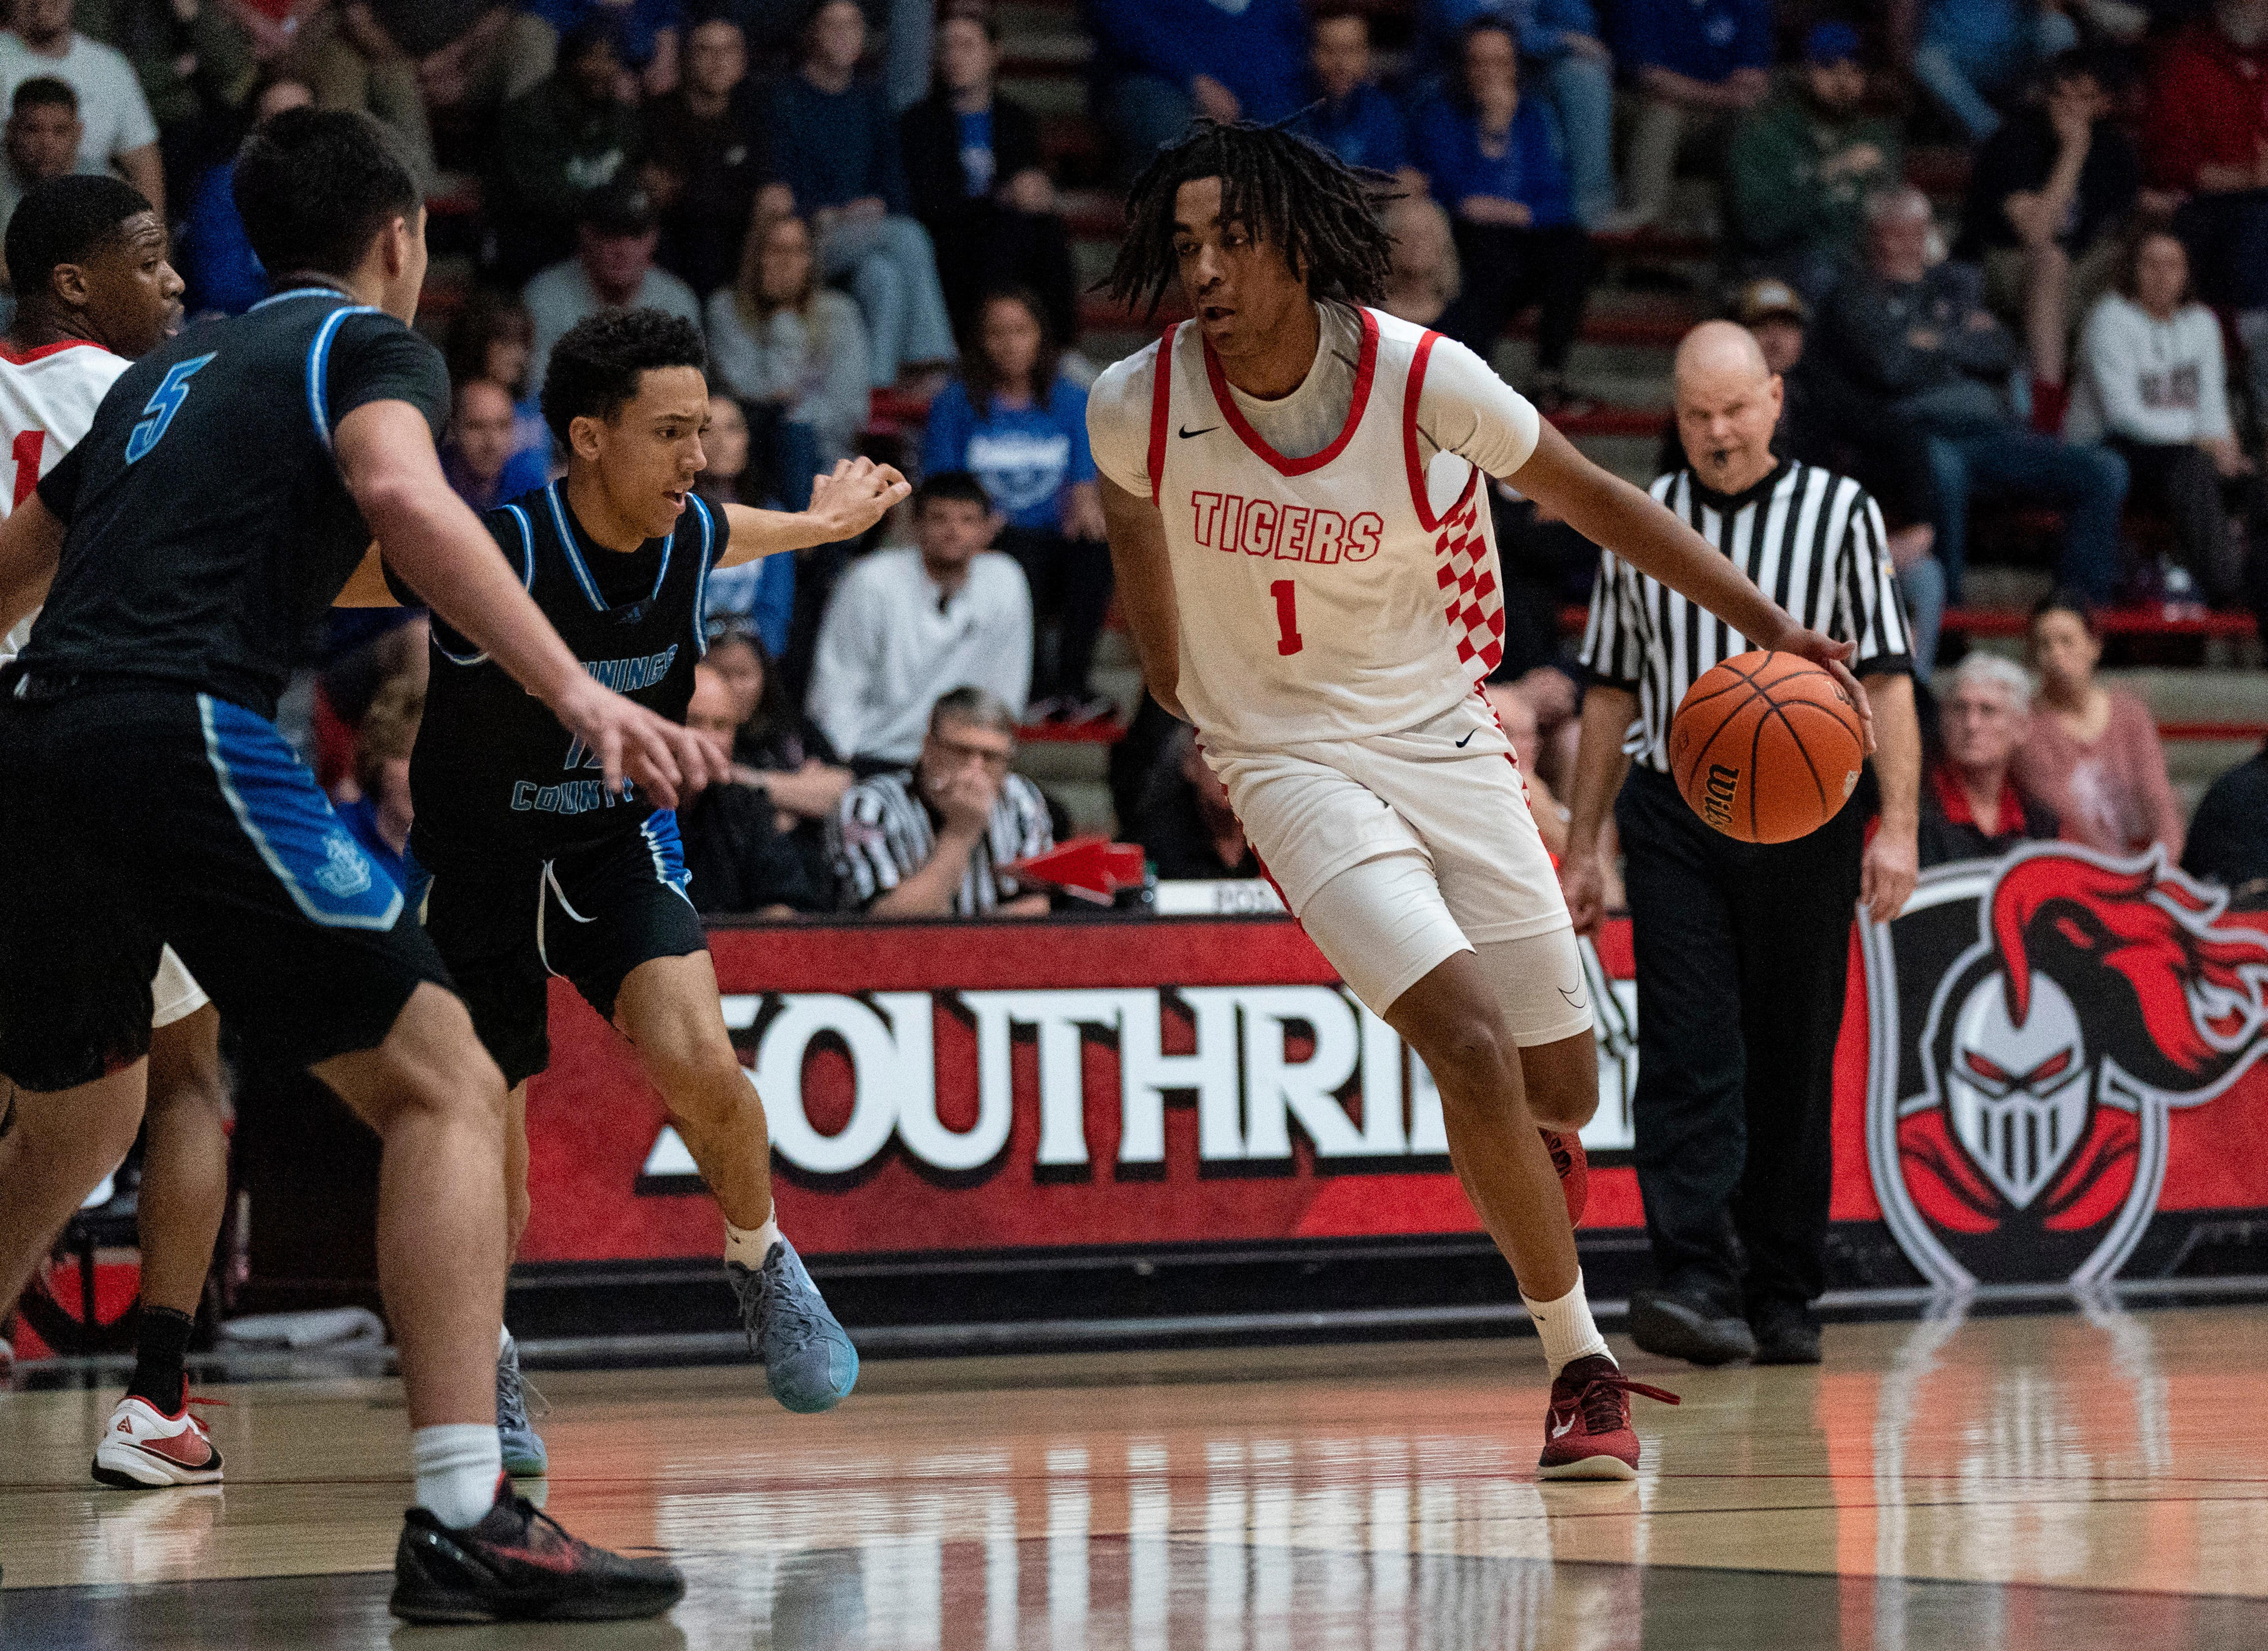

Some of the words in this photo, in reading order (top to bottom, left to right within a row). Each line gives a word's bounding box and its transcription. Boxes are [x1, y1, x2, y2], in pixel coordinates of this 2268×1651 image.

[125, 350, 217, 466] 5
[12, 430, 45, 508] 1
[1191, 490, 1384, 564] TIGERS
[1270, 580, 1304, 656] 1
